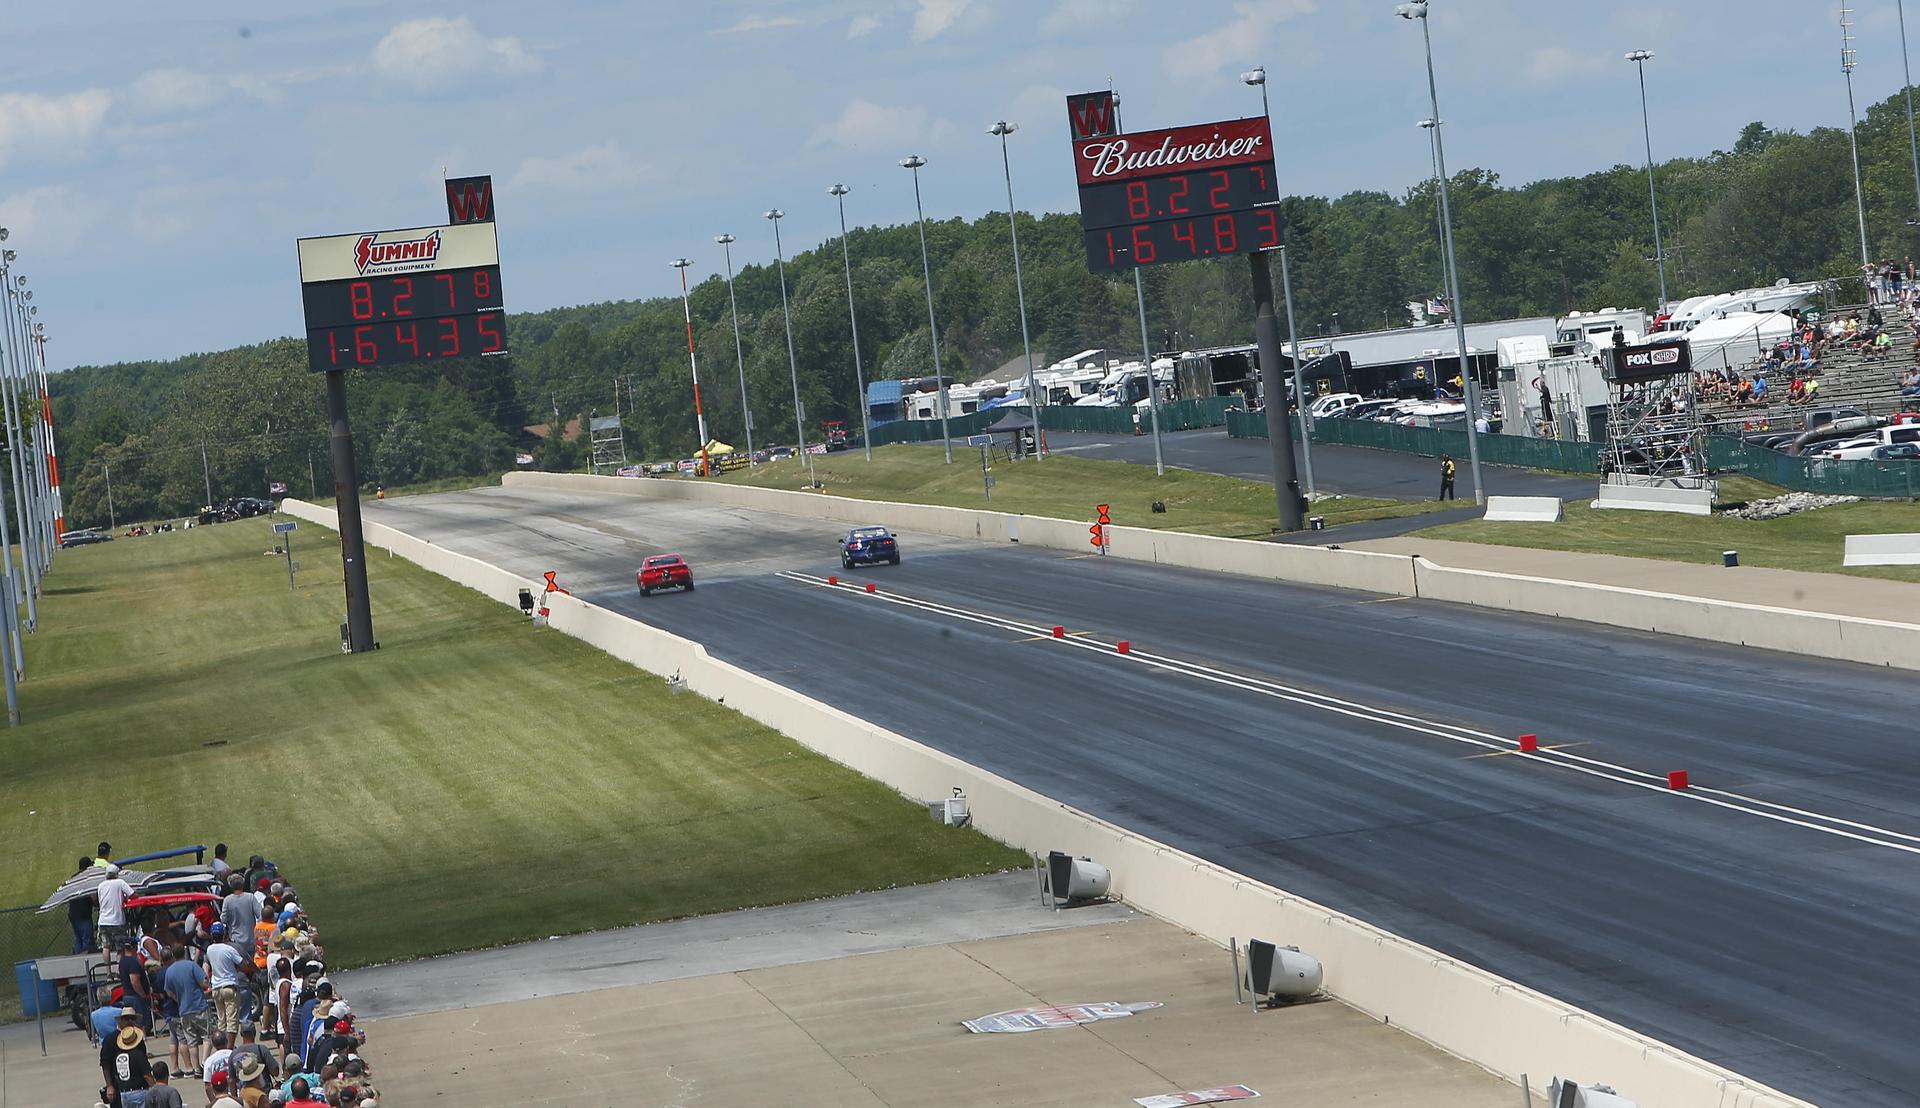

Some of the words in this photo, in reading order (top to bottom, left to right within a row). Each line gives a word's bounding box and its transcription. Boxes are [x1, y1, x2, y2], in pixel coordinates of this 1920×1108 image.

[1069, 97, 1112, 137] W
[1083, 134, 1263, 177] Budweiser
[448, 182, 491, 221] W
[394, 263, 435, 272] EQUIPMENT
[1626, 353, 1650, 366] FOX
[1654, 350, 1677, 361] NHRA
